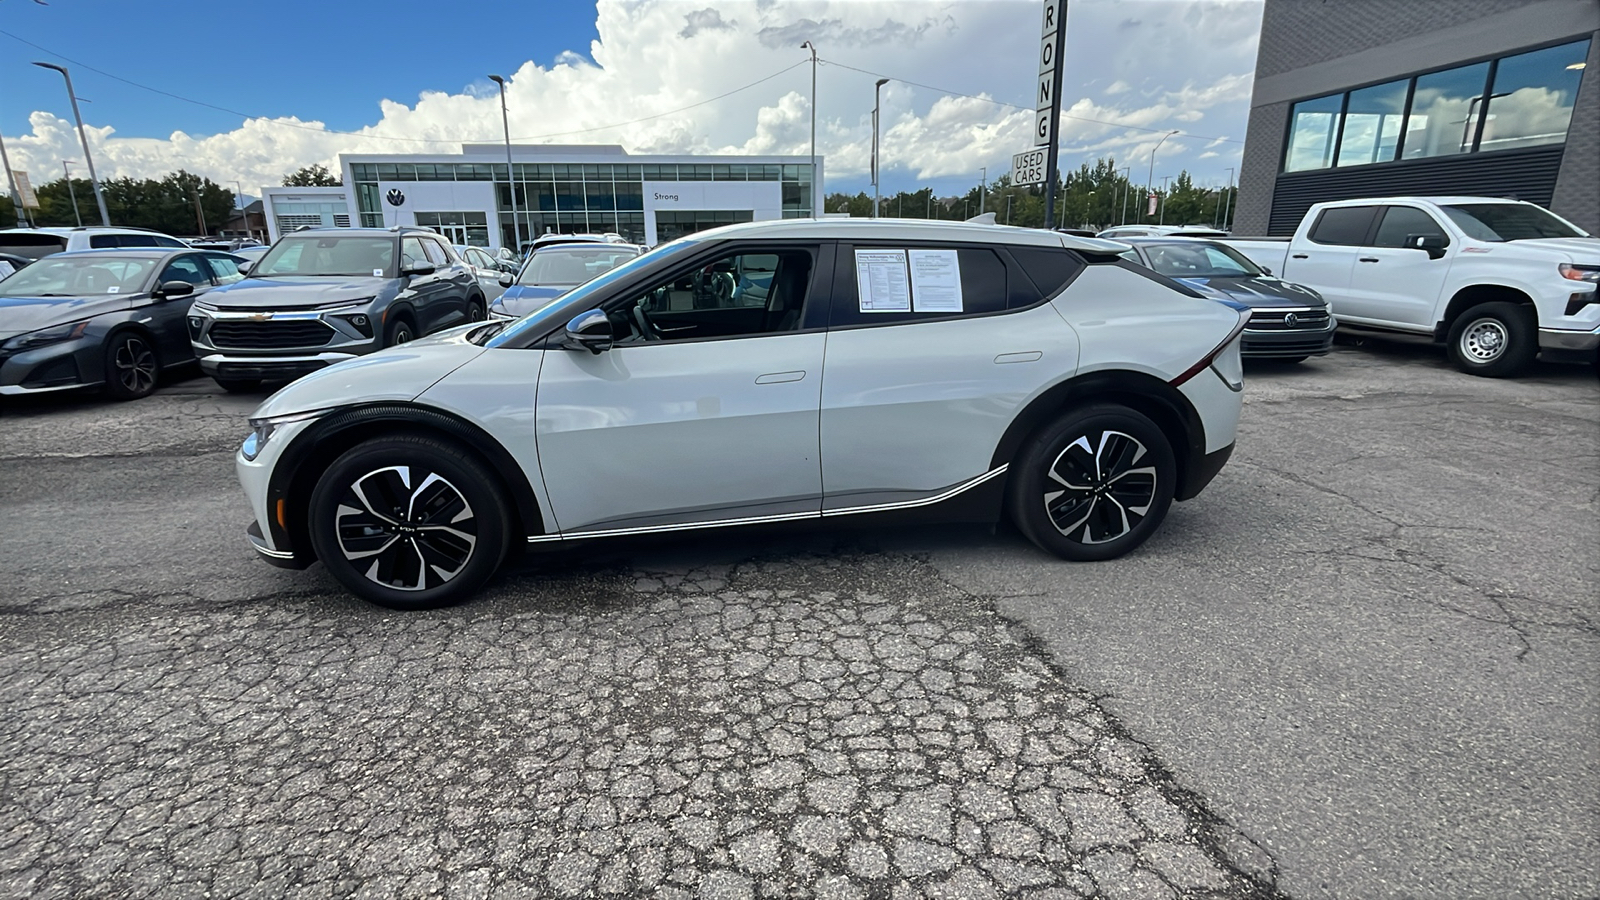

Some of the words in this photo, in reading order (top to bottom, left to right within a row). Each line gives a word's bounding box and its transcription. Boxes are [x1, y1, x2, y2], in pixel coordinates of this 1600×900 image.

[1015, 152, 1044, 170] USED
[1015, 166, 1042, 184] CARS
[654, 192, 679, 202] Strong
